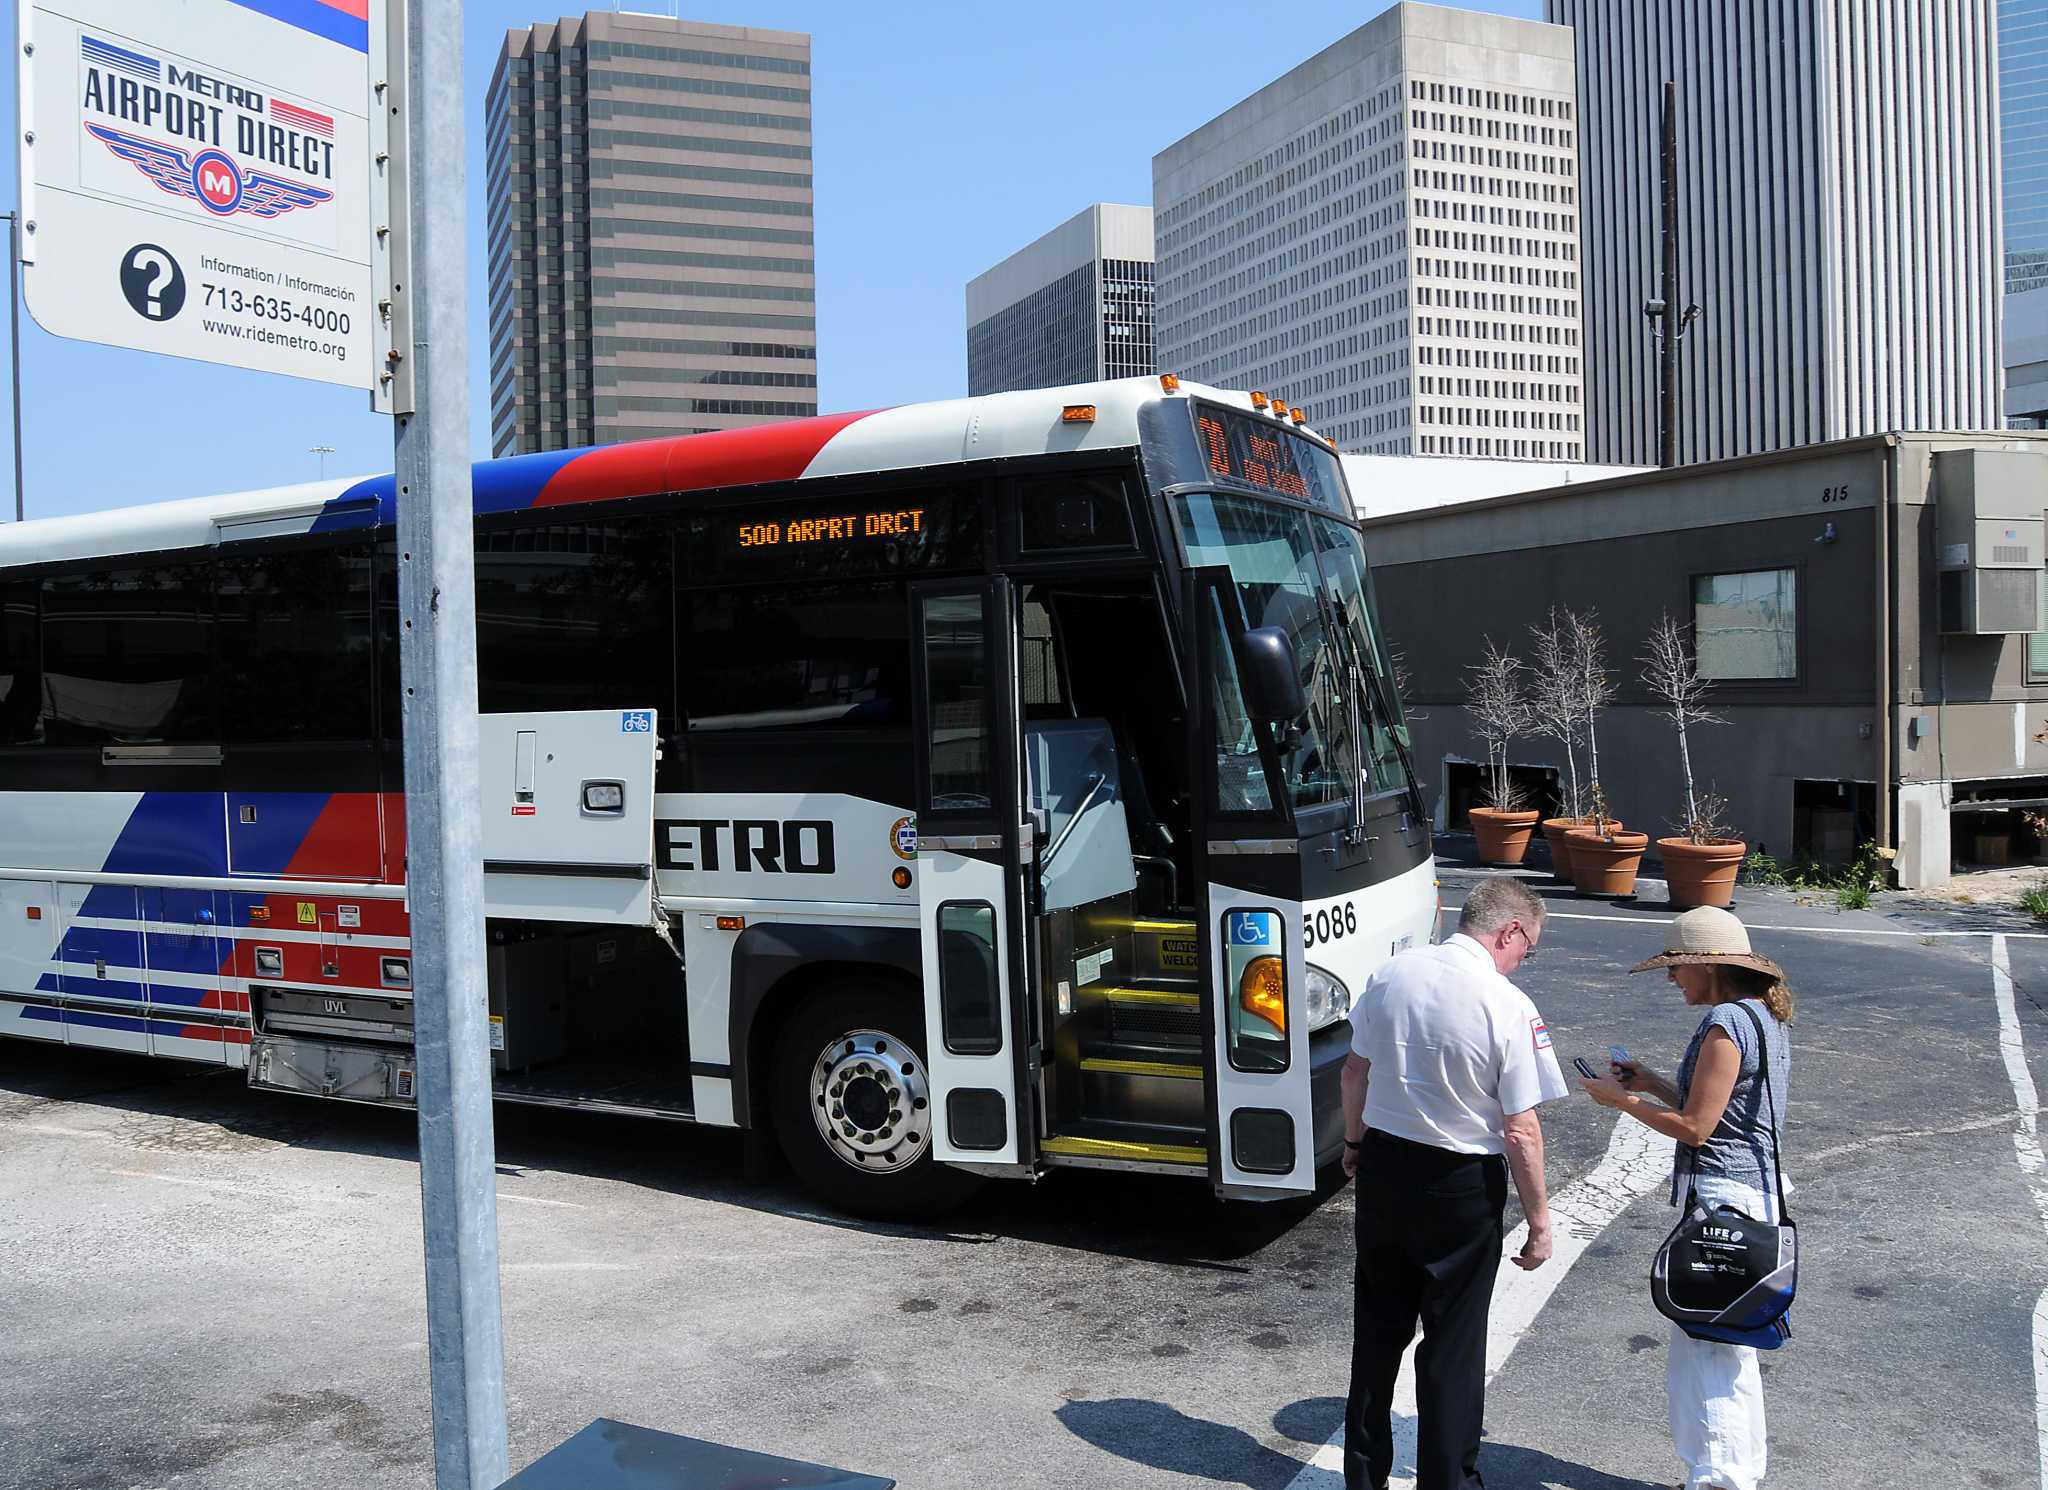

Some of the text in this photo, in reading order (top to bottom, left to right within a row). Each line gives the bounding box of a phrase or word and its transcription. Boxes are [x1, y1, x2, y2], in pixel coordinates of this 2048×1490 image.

[168, 64, 263, 113] METRO
[84, 67, 334, 179] AIRPORT DIRECT
[204, 170, 231, 196] M
[201, 255, 274, 284] Information
[286, 274, 355, 301] Información
[202, 283, 350, 334] 713-635-4000
[203, 319, 346, 361] www.ridemetro.org
[1822, 485, 1849, 502] 815
[739, 510, 924, 547] 500 ARPRT DRCT
[654, 819, 836, 874] ETRO
[1303, 901, 1357, 949] 5086
[1166, 941, 1199, 952] WATC
[325, 999, 346, 1014] UVL
[1703, 1226, 1729, 1238] LIFE
